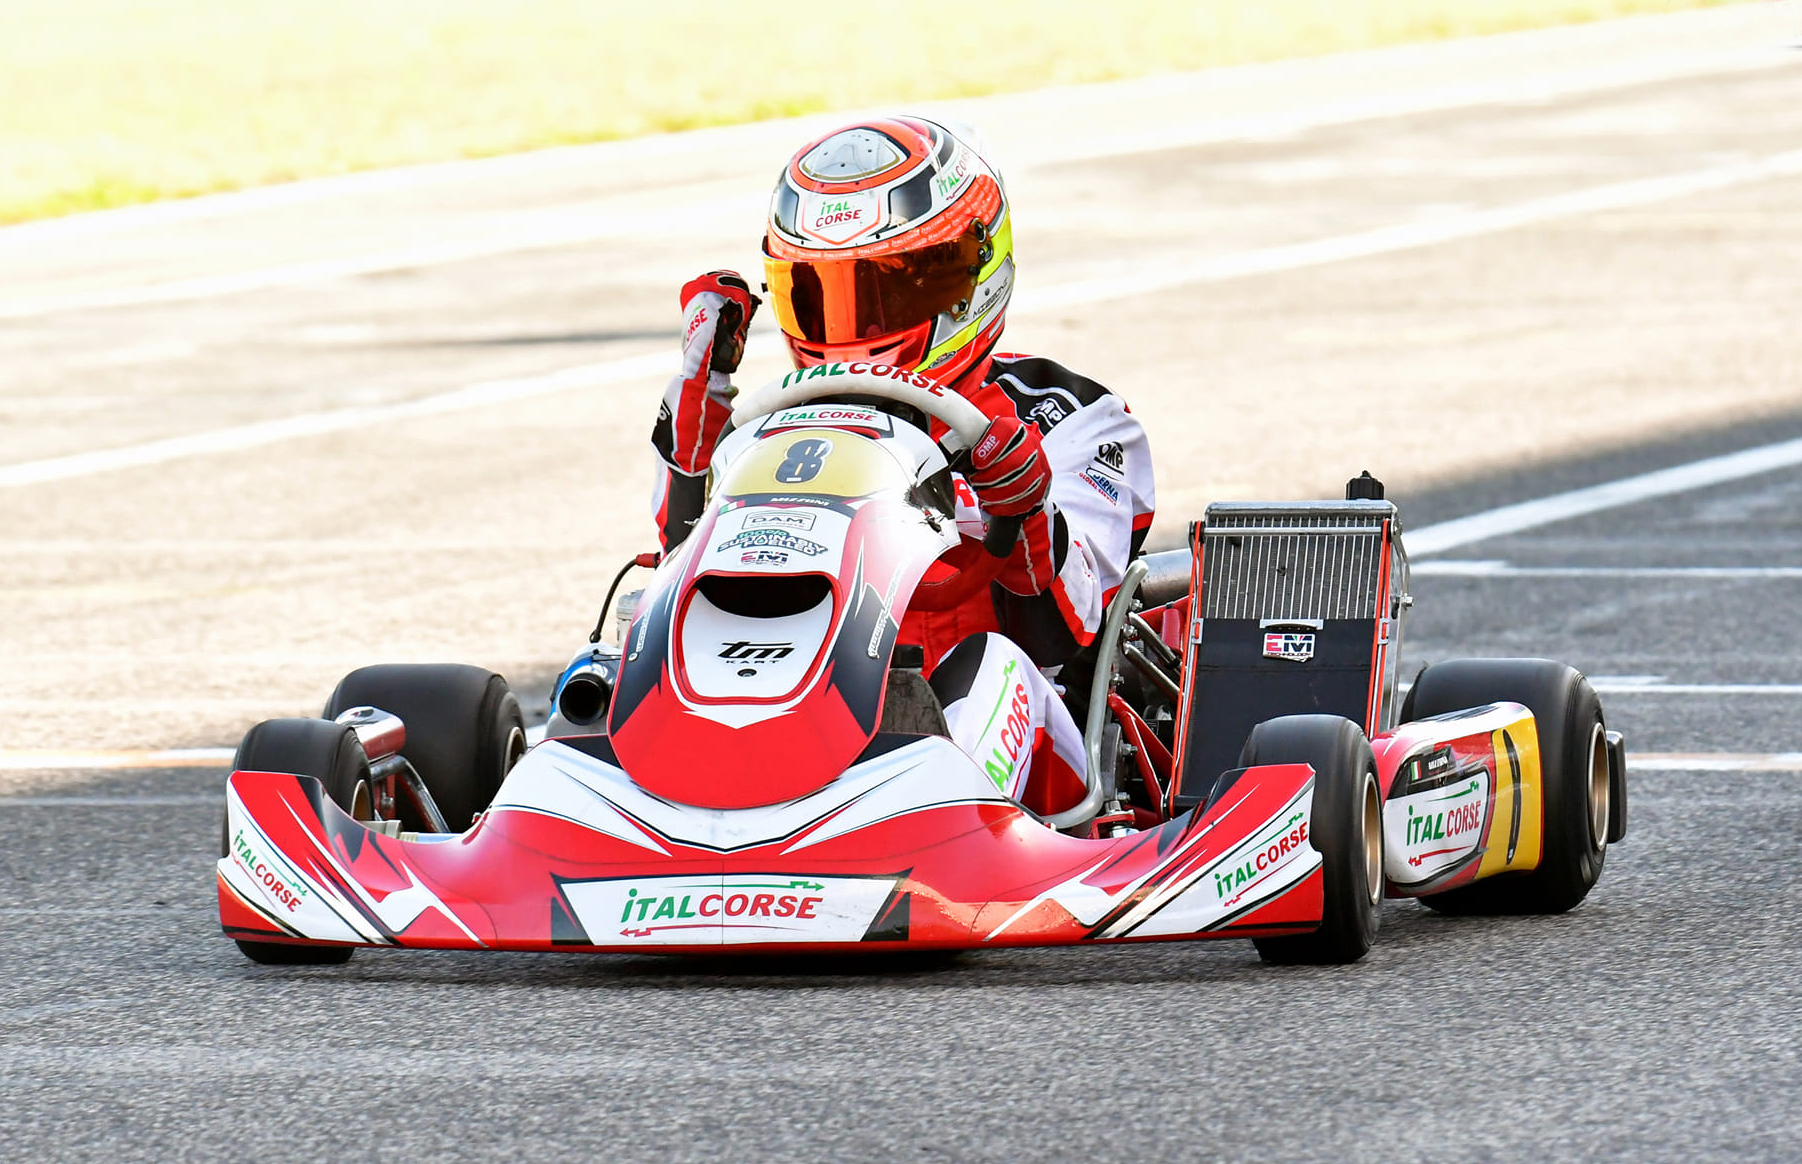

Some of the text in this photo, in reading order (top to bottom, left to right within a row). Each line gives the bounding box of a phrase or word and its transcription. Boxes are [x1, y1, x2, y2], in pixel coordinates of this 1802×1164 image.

[815, 209, 862, 228] CORSE
[782, 362, 946, 397] ITALCORSE
[978, 436, 996, 457] OMP
[1098, 443, 1123, 468] OMP
[775, 438, 832, 483] 8
[719, 535, 827, 553] SUSTAINABLY
